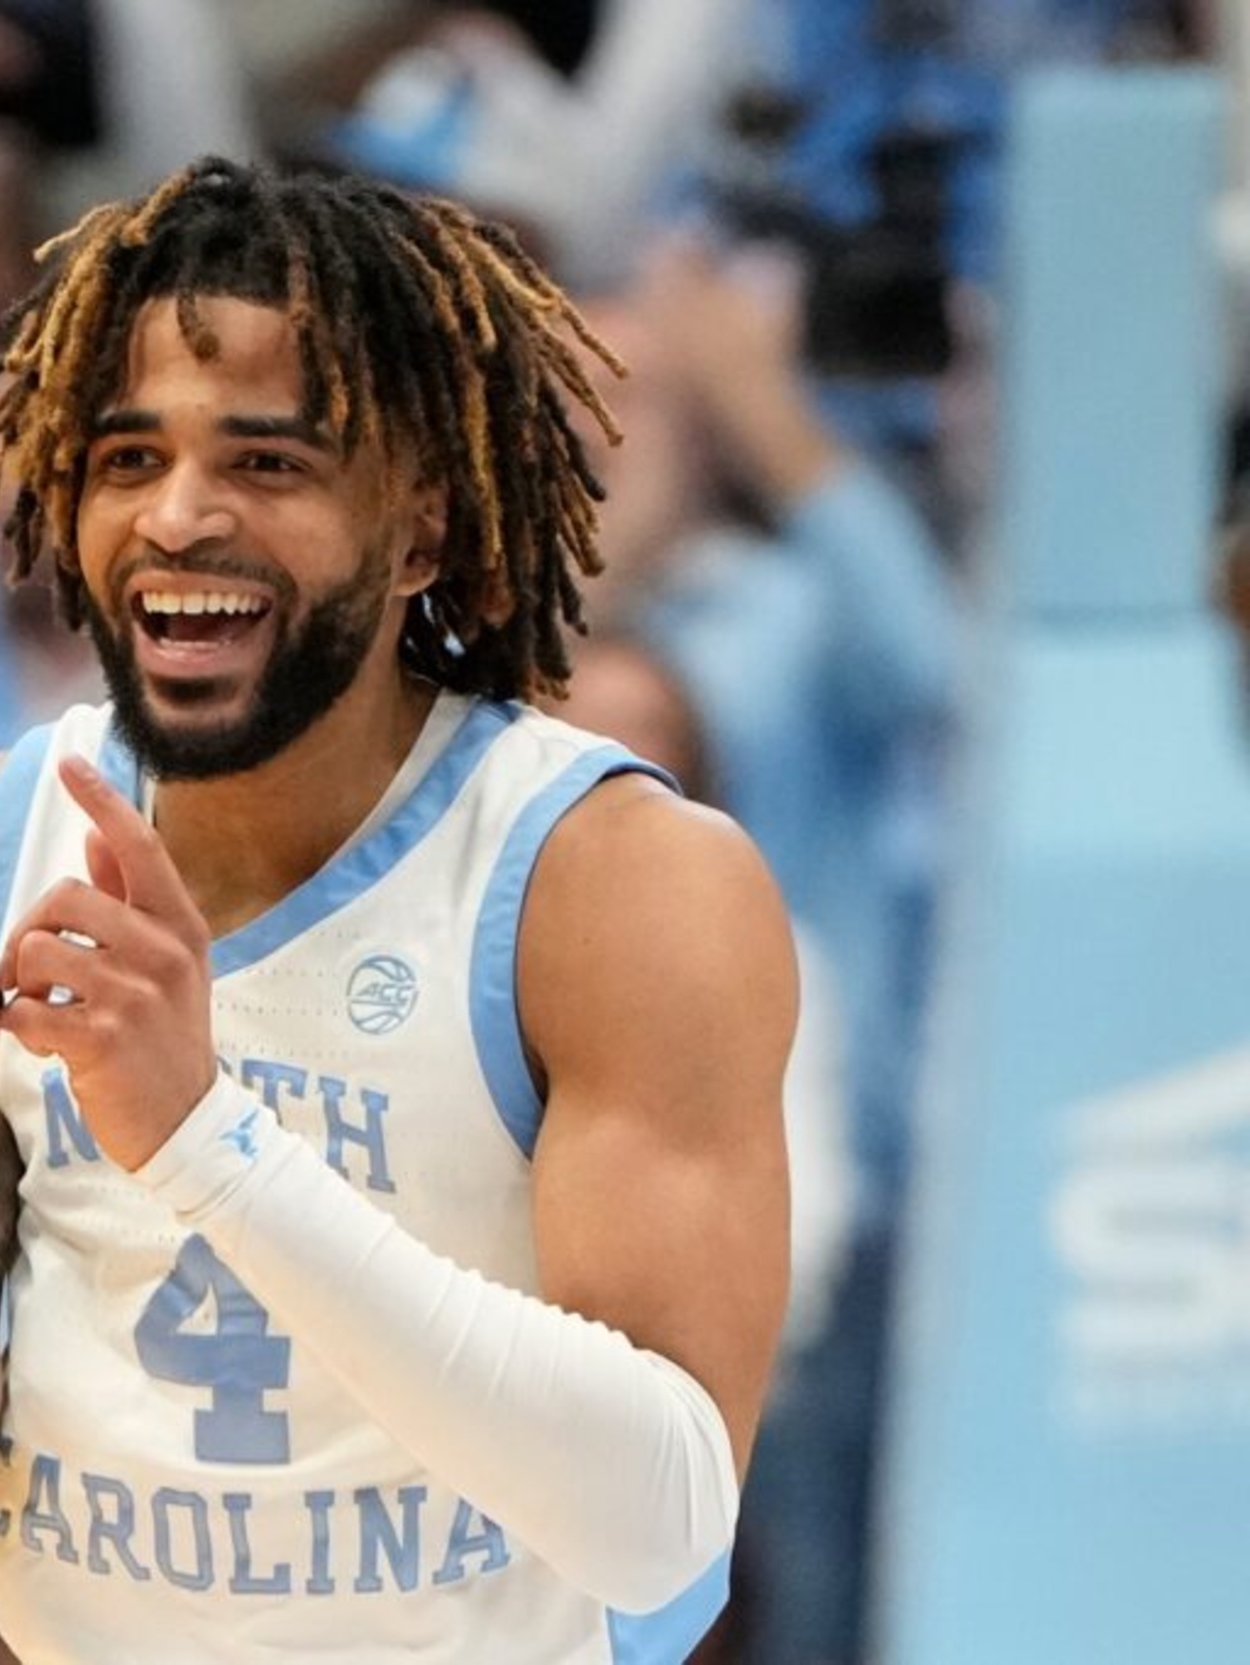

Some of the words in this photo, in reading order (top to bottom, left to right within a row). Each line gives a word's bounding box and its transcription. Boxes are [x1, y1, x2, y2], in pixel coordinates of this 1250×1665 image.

[355, 981, 414, 1007] ACC
[39, 1055, 397, 1194] NTH
[134, 1232, 291, 1465] 4
